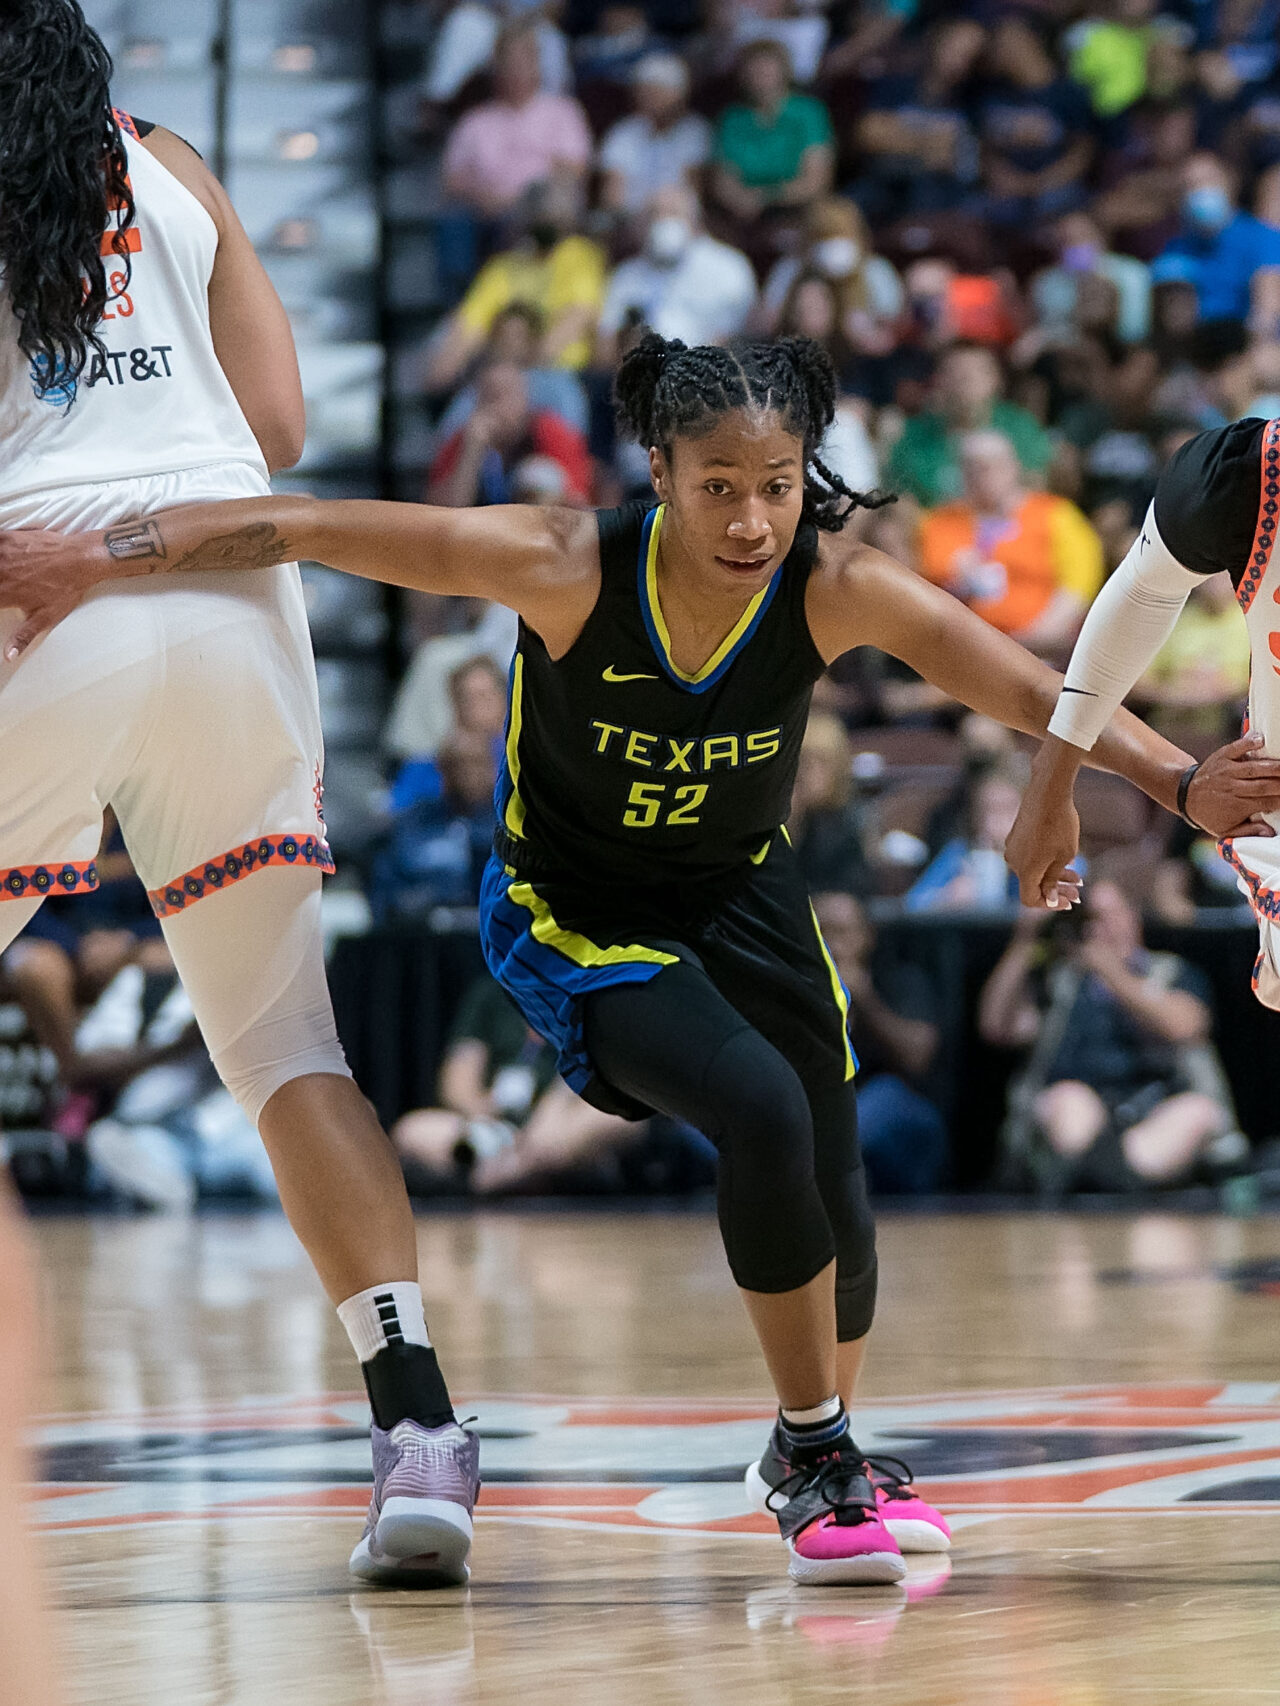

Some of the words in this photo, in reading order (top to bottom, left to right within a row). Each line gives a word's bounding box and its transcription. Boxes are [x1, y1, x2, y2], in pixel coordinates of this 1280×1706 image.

[87, 345, 172, 388] AT&T
[589, 719, 784, 774] TEXAS
[622, 781, 709, 828] 52
